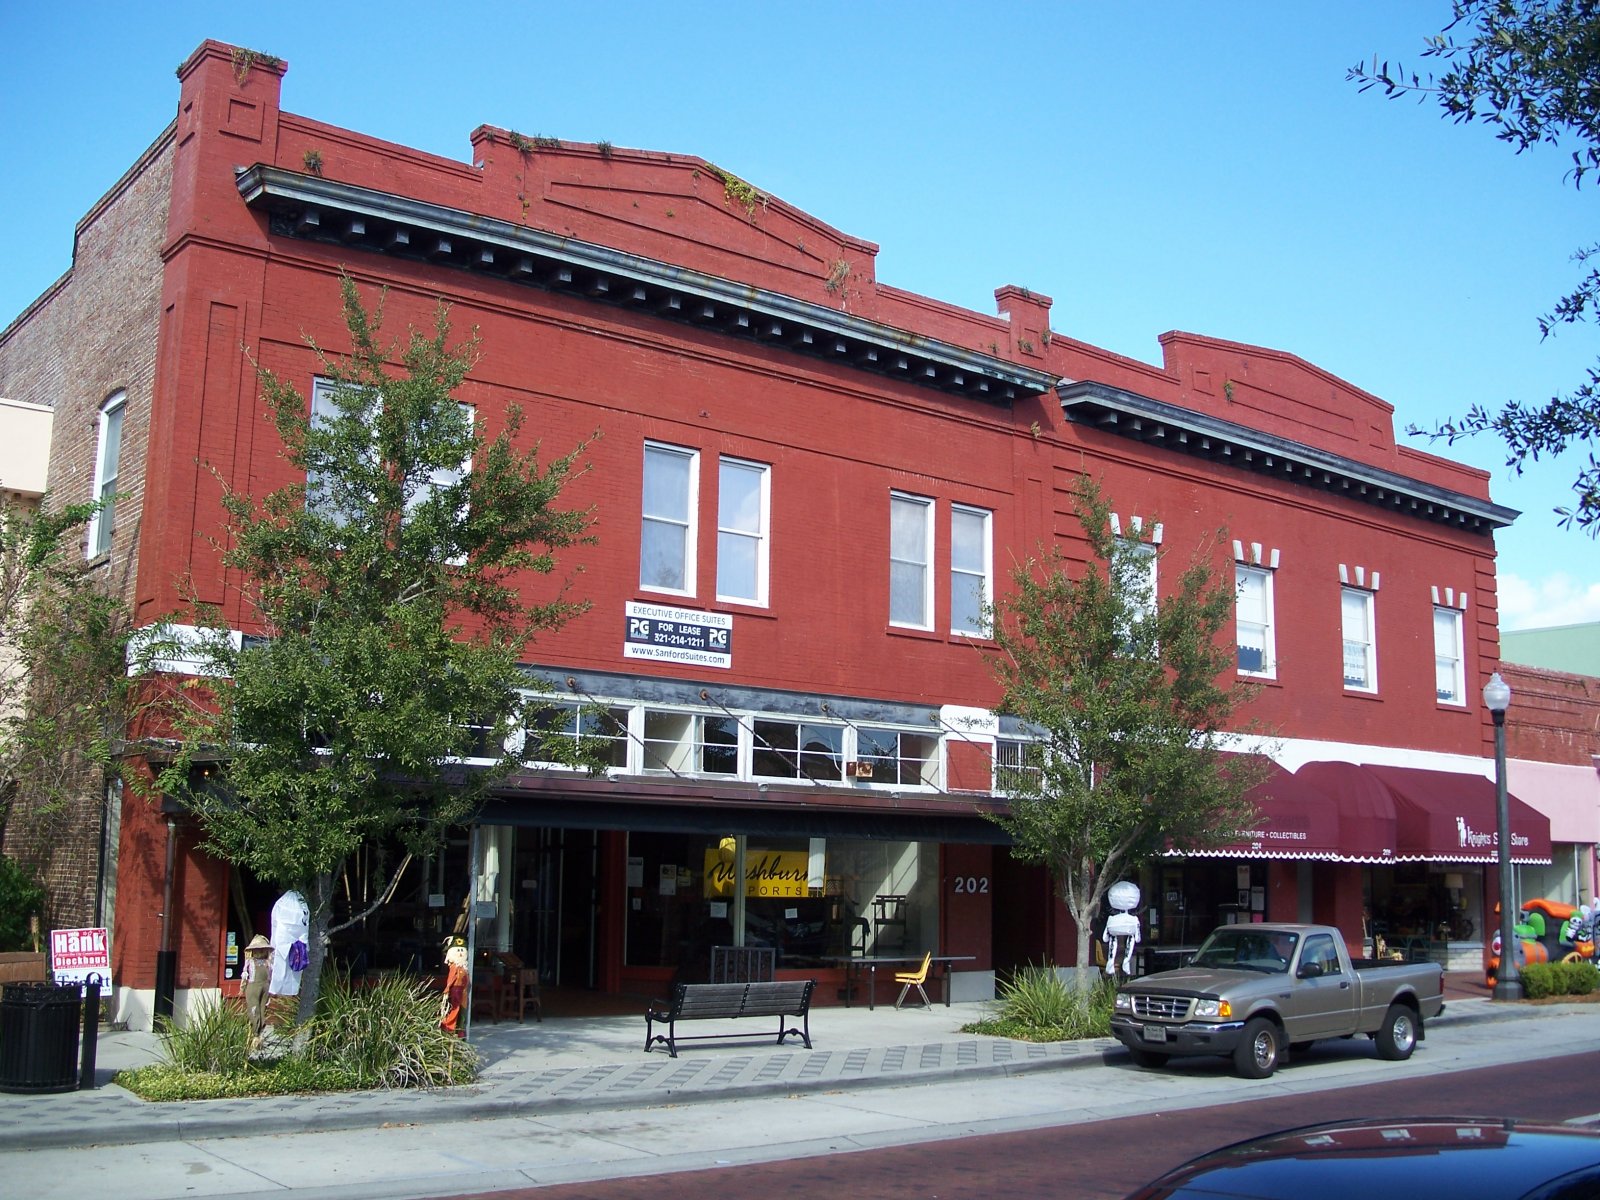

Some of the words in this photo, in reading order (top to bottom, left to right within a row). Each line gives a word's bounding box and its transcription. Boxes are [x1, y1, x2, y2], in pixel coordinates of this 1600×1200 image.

[633, 606, 672, 619] EXECUTIVE
[674, 611, 700, 622] OFFICE
[702, 615, 726, 625] SUITES
[658, 622, 674, 633] FOR
[679, 625, 701, 636] LEASE
[654, 632, 705, 647] 321-214-1211
[631, 646, 725, 664] www.SanfordSuites.com
[1269, 831, 1306, 840] COLLECTIBLES
[1511, 833, 1529, 846] Store
[955, 876, 988, 893] 202
[54, 931, 105, 953] Hank
[55, 955, 107, 966] Dieckhaus
